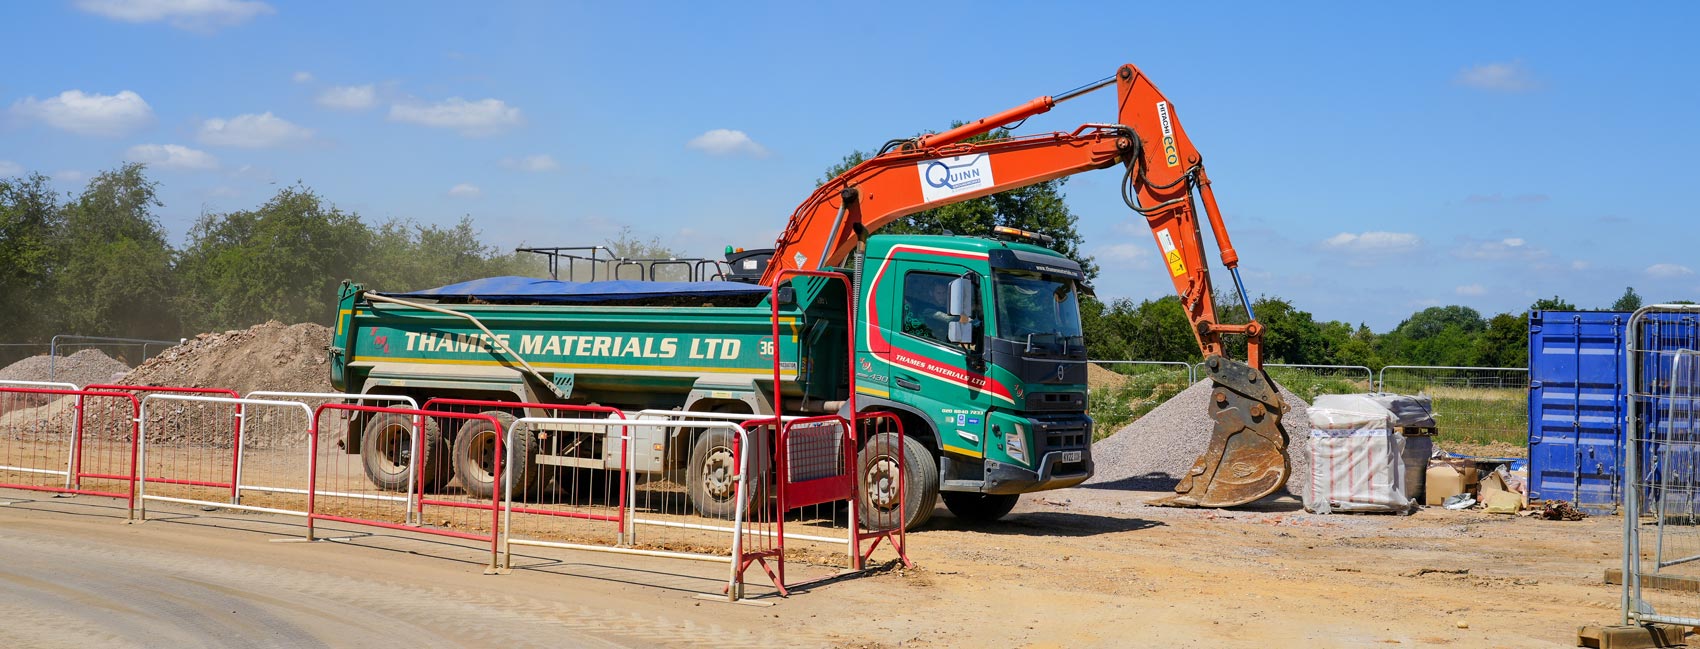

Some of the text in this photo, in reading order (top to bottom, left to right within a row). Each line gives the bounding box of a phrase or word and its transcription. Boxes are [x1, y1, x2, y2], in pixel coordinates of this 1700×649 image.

[1159, 103, 1178, 165] HITACHI eco
[925, 161, 980, 189] QUINN
[404, 331, 742, 360] THAMES MATERIALS LTD
[759, 341, 774, 355] 36
[895, 354, 987, 387] THAMES MATERIALS LTD
